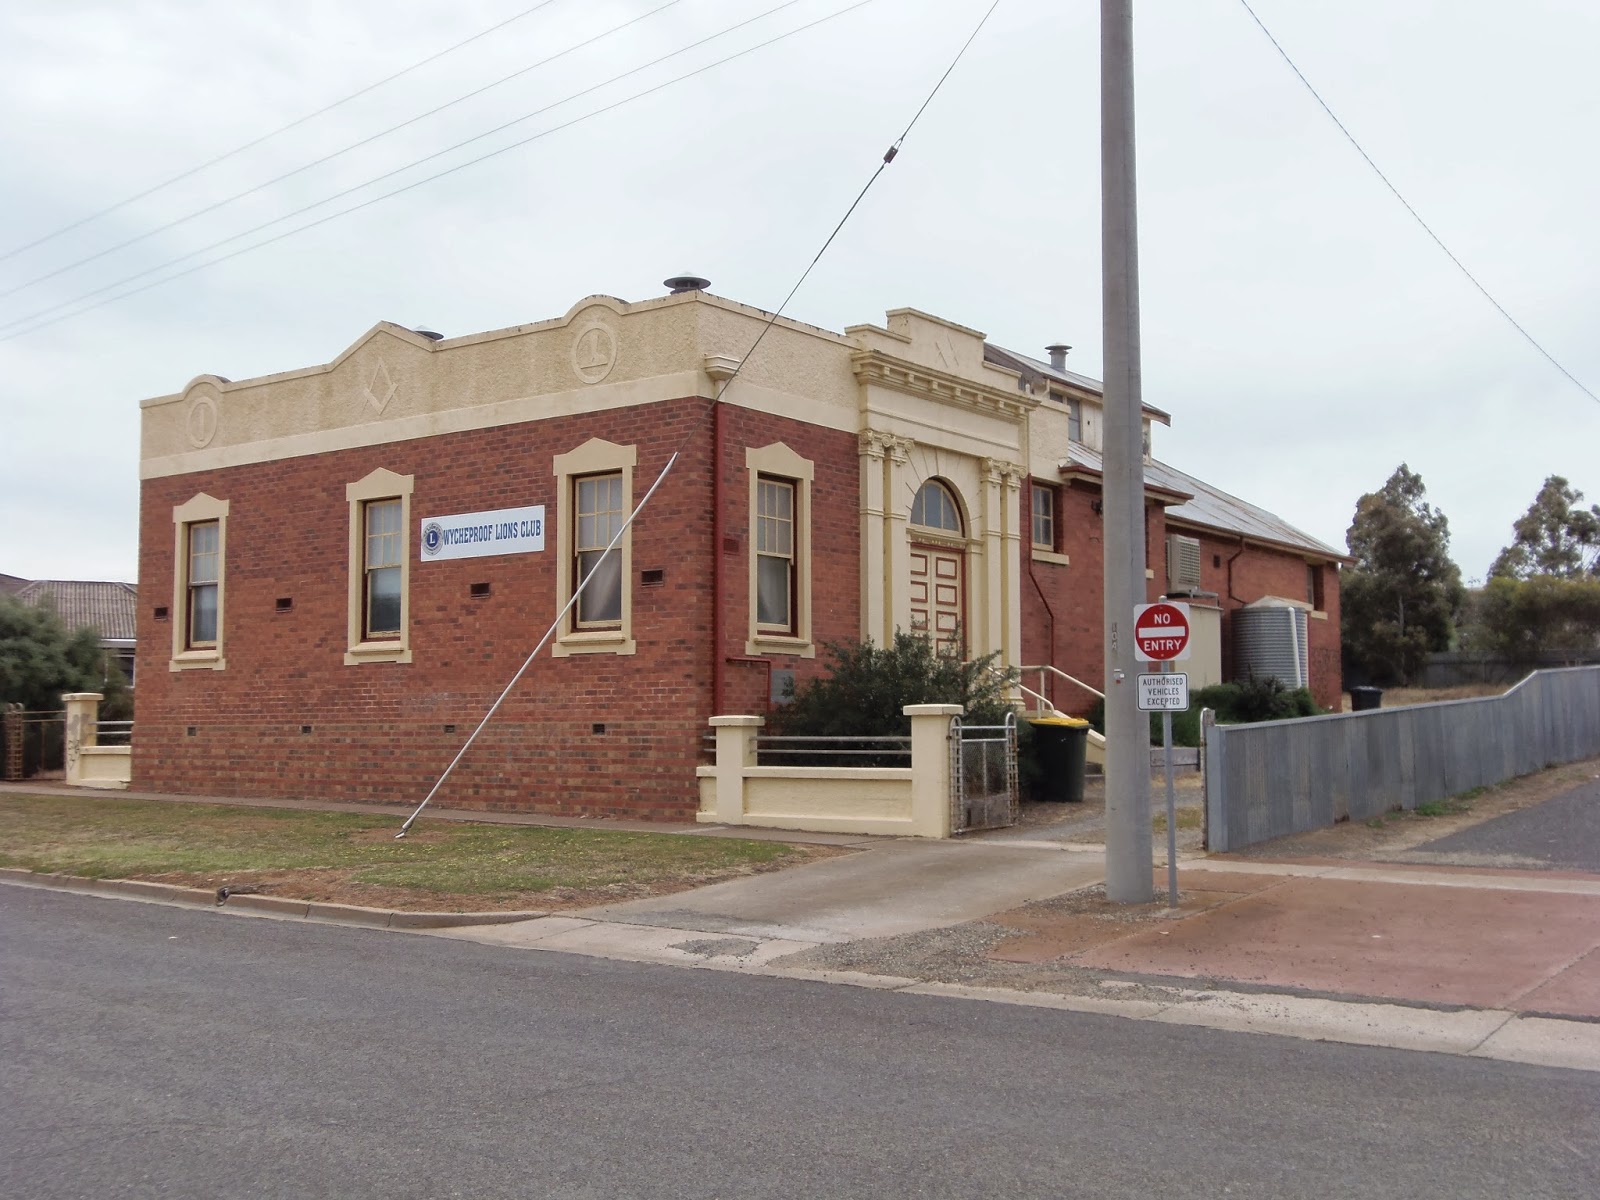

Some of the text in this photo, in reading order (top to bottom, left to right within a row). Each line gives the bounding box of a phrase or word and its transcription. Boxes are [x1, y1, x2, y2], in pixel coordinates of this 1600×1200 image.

[443, 524, 493, 546] WYCHEPROOF
[495, 521, 518, 540] LIONS
[520, 519, 541, 538] CLUB
[1154, 613, 1171, 624] NO
[1143, 639, 1182, 652] ENTRY
[1143, 677, 1184, 686] AUTHORISED
[1147, 687, 1180, 696] VEHICLES
[1147, 697, 1180, 706] EXCEPTED
